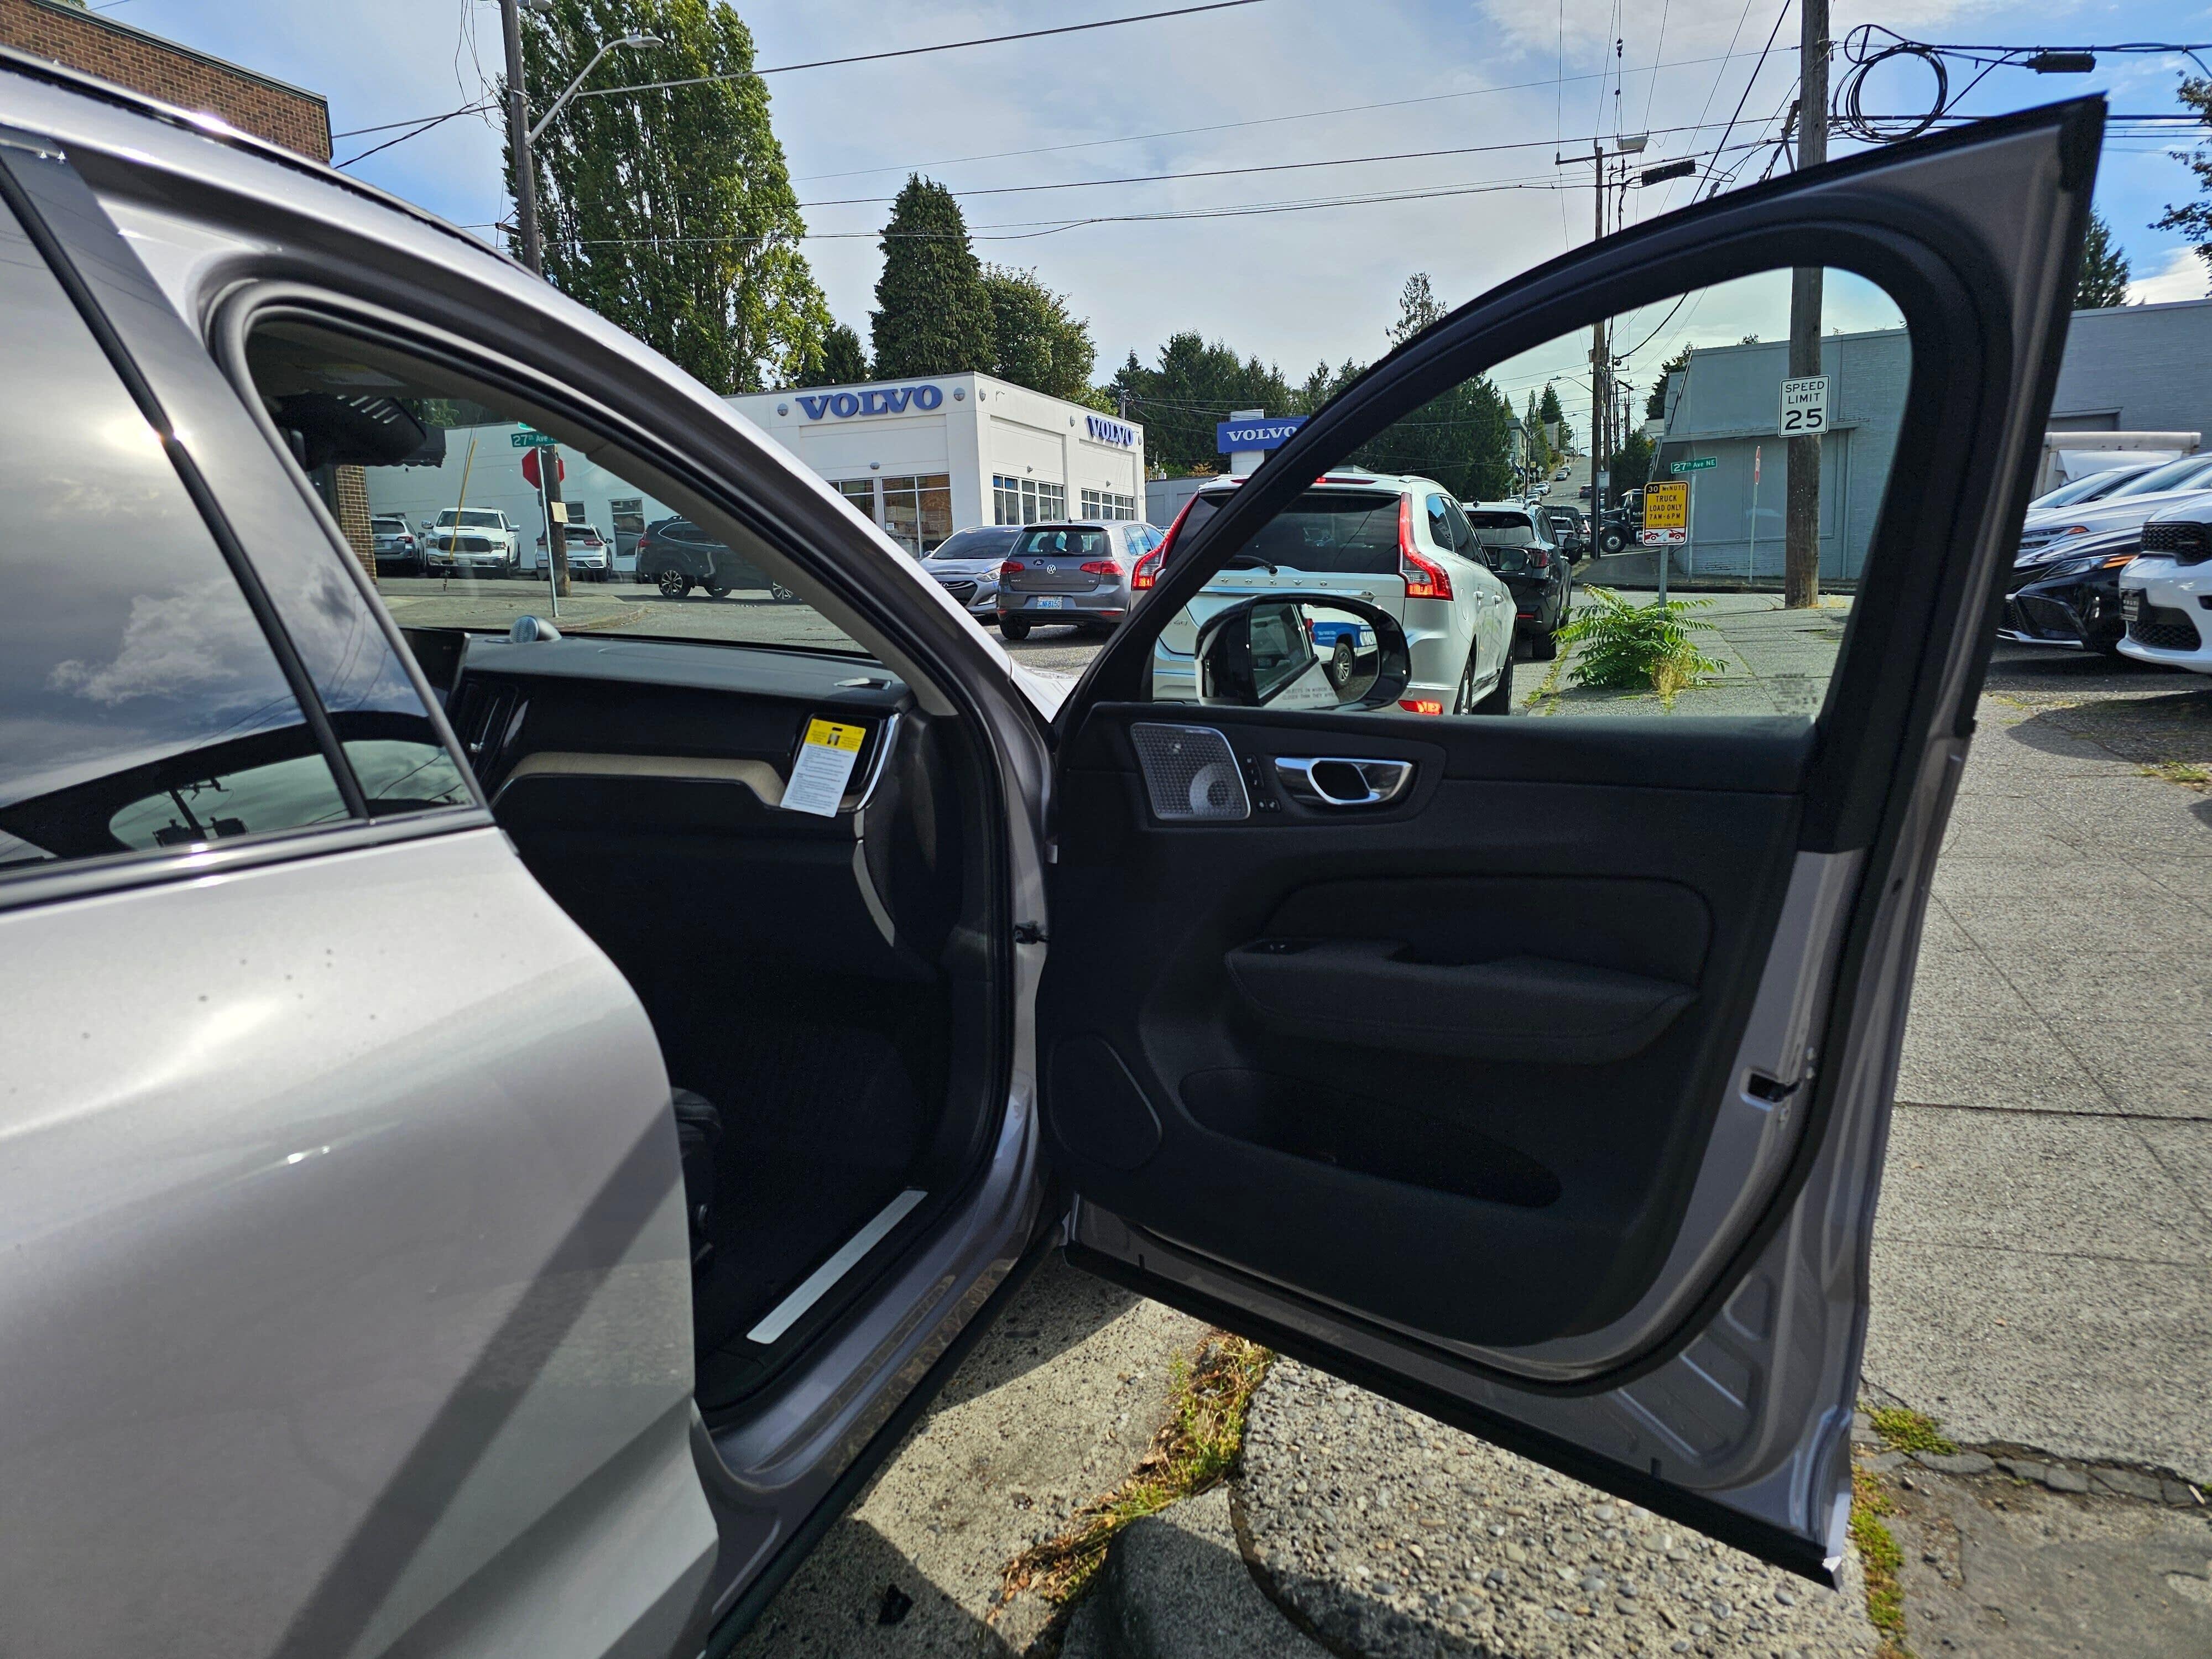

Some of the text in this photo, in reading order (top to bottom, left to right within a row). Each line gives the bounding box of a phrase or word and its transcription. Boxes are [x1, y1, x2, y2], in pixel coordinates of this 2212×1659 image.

[1785, 381, 1825, 393] SPEED
[795, 385, 943, 420] VOLVO
[1788, 393, 1820, 404] LIMIT
[1785, 408, 1823, 430] 25
[1087, 416, 1133, 446] VOLVO
[1227, 426, 1297, 441] VOLVO
